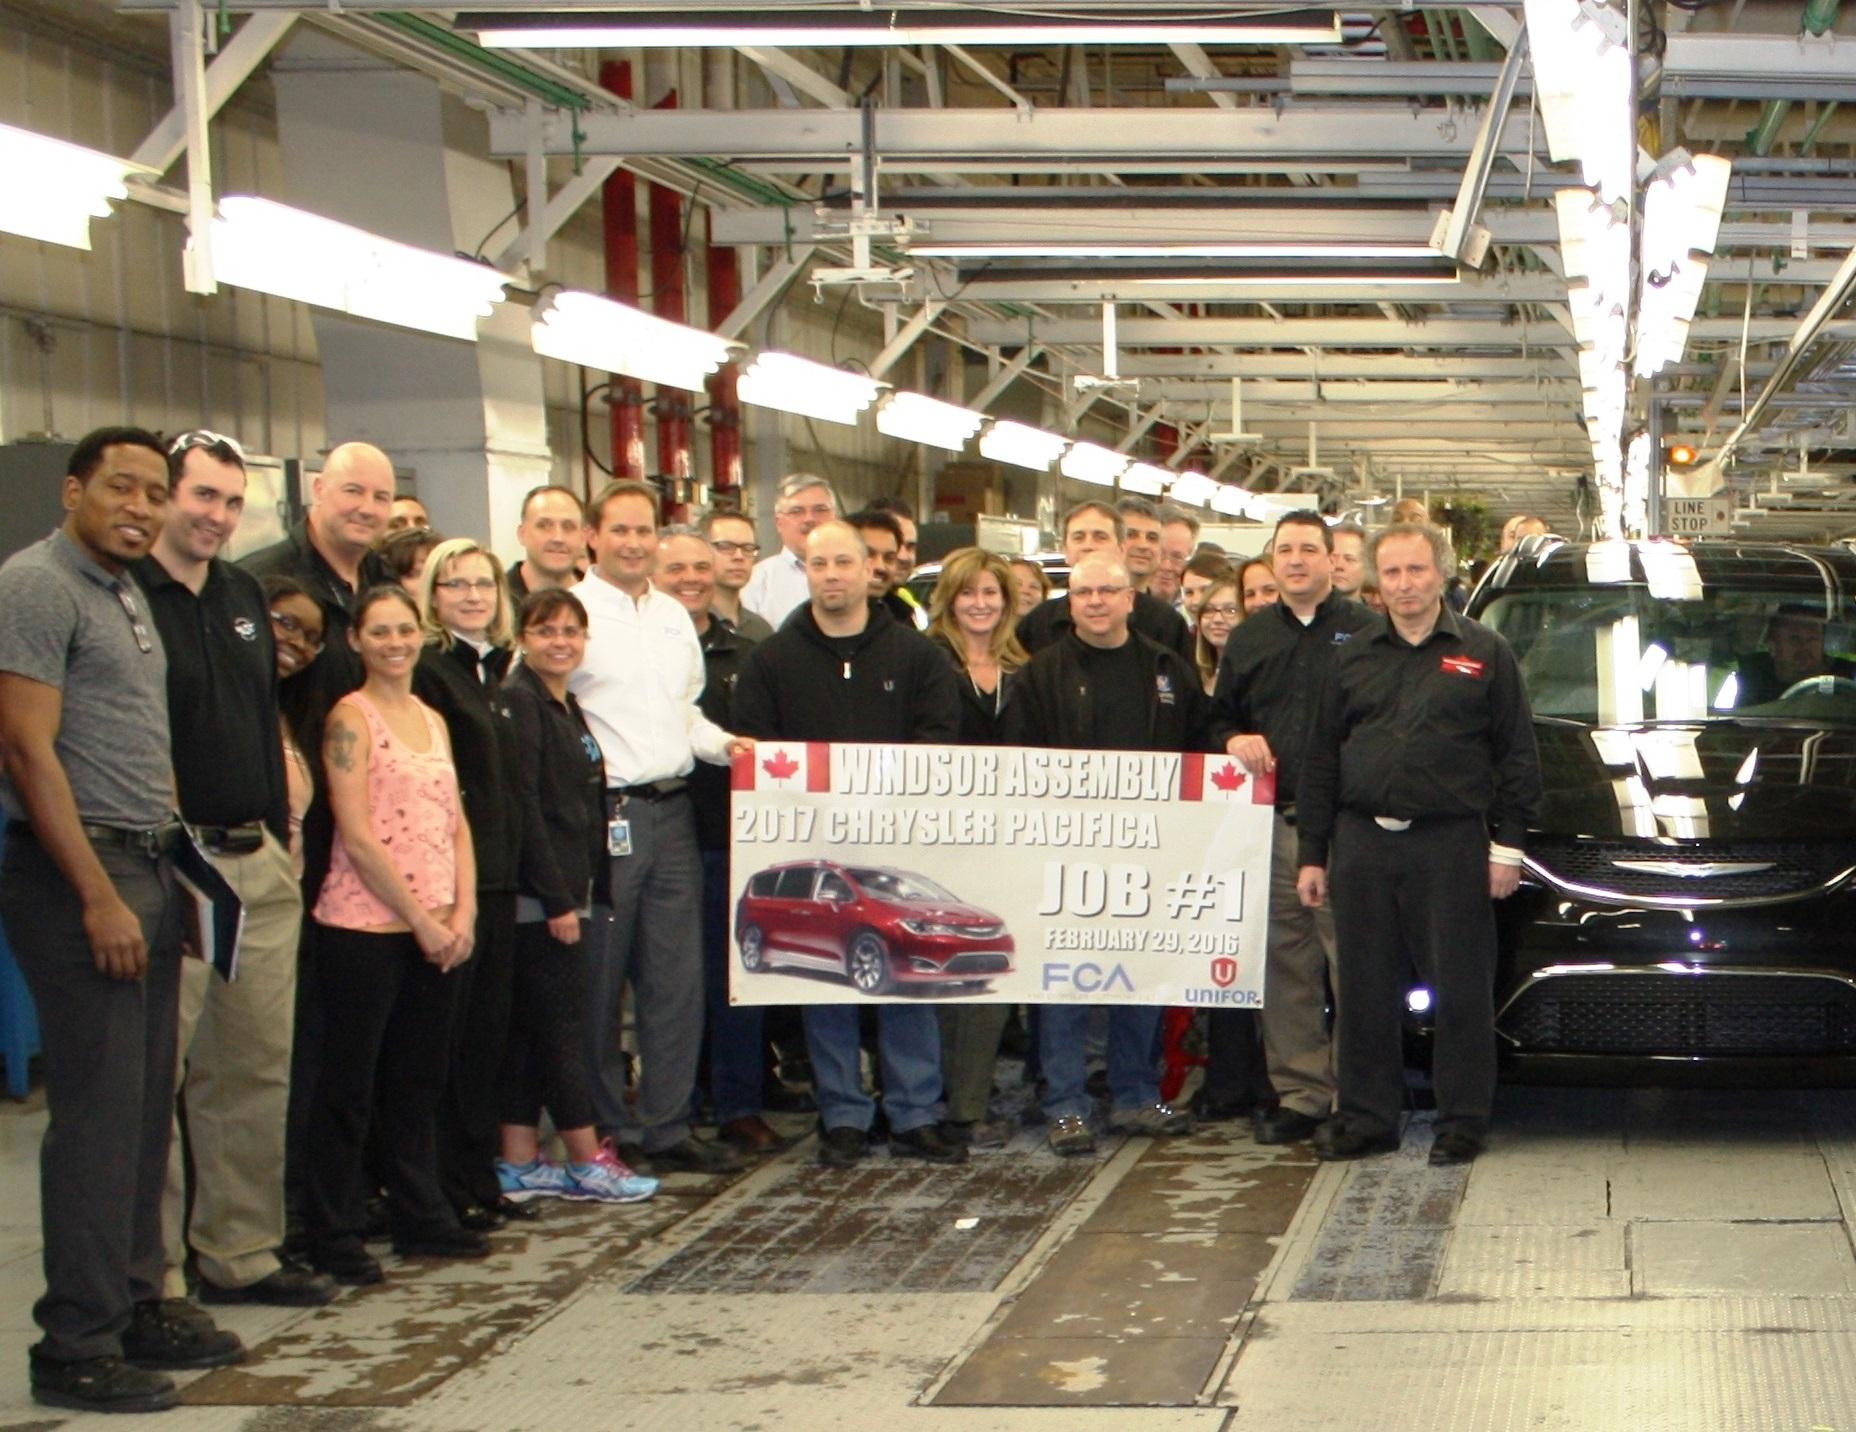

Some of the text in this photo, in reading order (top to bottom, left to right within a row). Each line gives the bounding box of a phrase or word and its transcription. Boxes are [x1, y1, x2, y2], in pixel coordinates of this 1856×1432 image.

[1674, 501, 1705, 515] LINE
[1671, 517, 1708, 531] STOP
[837, 747, 1179, 802] WINDSOR ASSEMBLY
[735, 806, 1160, 849] 2017 CHRYSLER PACIFICA
[1038, 861, 1245, 922] JOB #1
[1045, 927, 1240, 956] FEBRUARY 29, 2016
[1041, 962, 1136, 993] FCA
